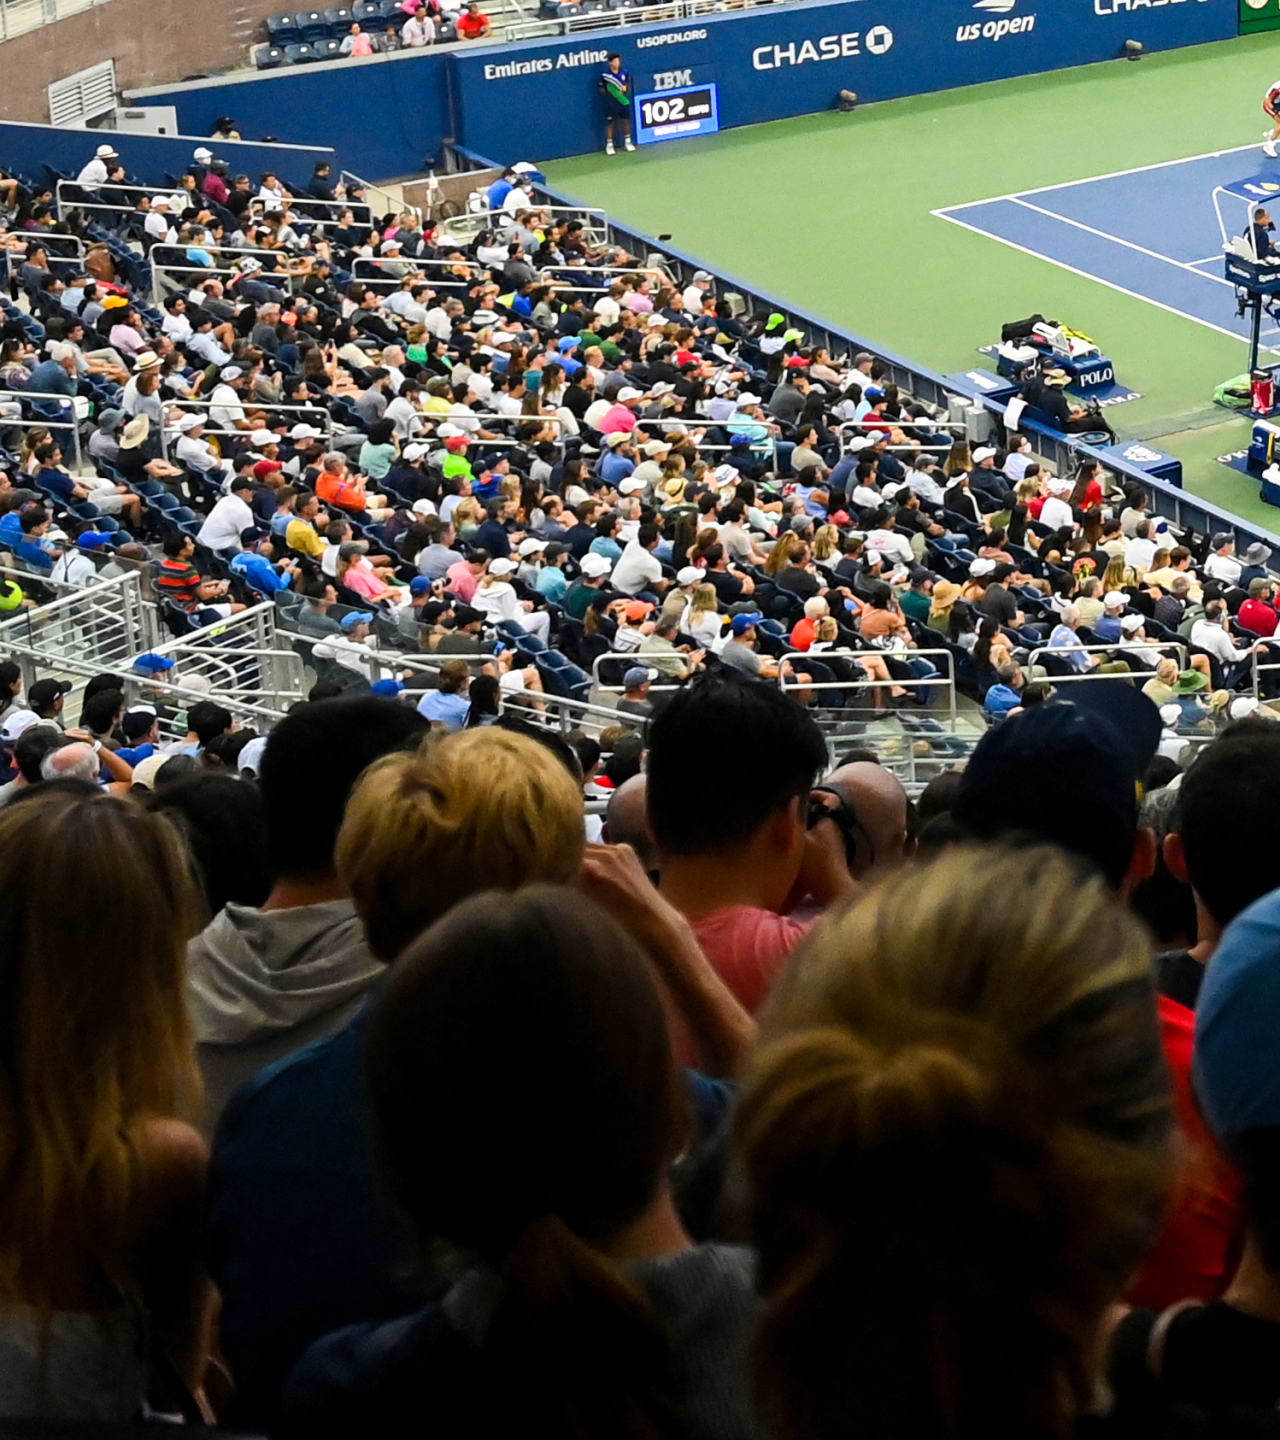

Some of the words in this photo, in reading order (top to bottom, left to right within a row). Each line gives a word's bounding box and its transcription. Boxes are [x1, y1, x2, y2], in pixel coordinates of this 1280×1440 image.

[636, 28, 708, 49] USOPEN.ORG
[956, 23, 982, 42] us
[982, 15, 1035, 42] open
[484, 58, 553, 80] Emirates
[555, 49, 608, 70] Airline
[752, 31, 860, 71] CHASE
[653, 68, 694, 92] IBM
[641, 97, 686, 125] 102
[1079, 367, 1113, 388] POLO
